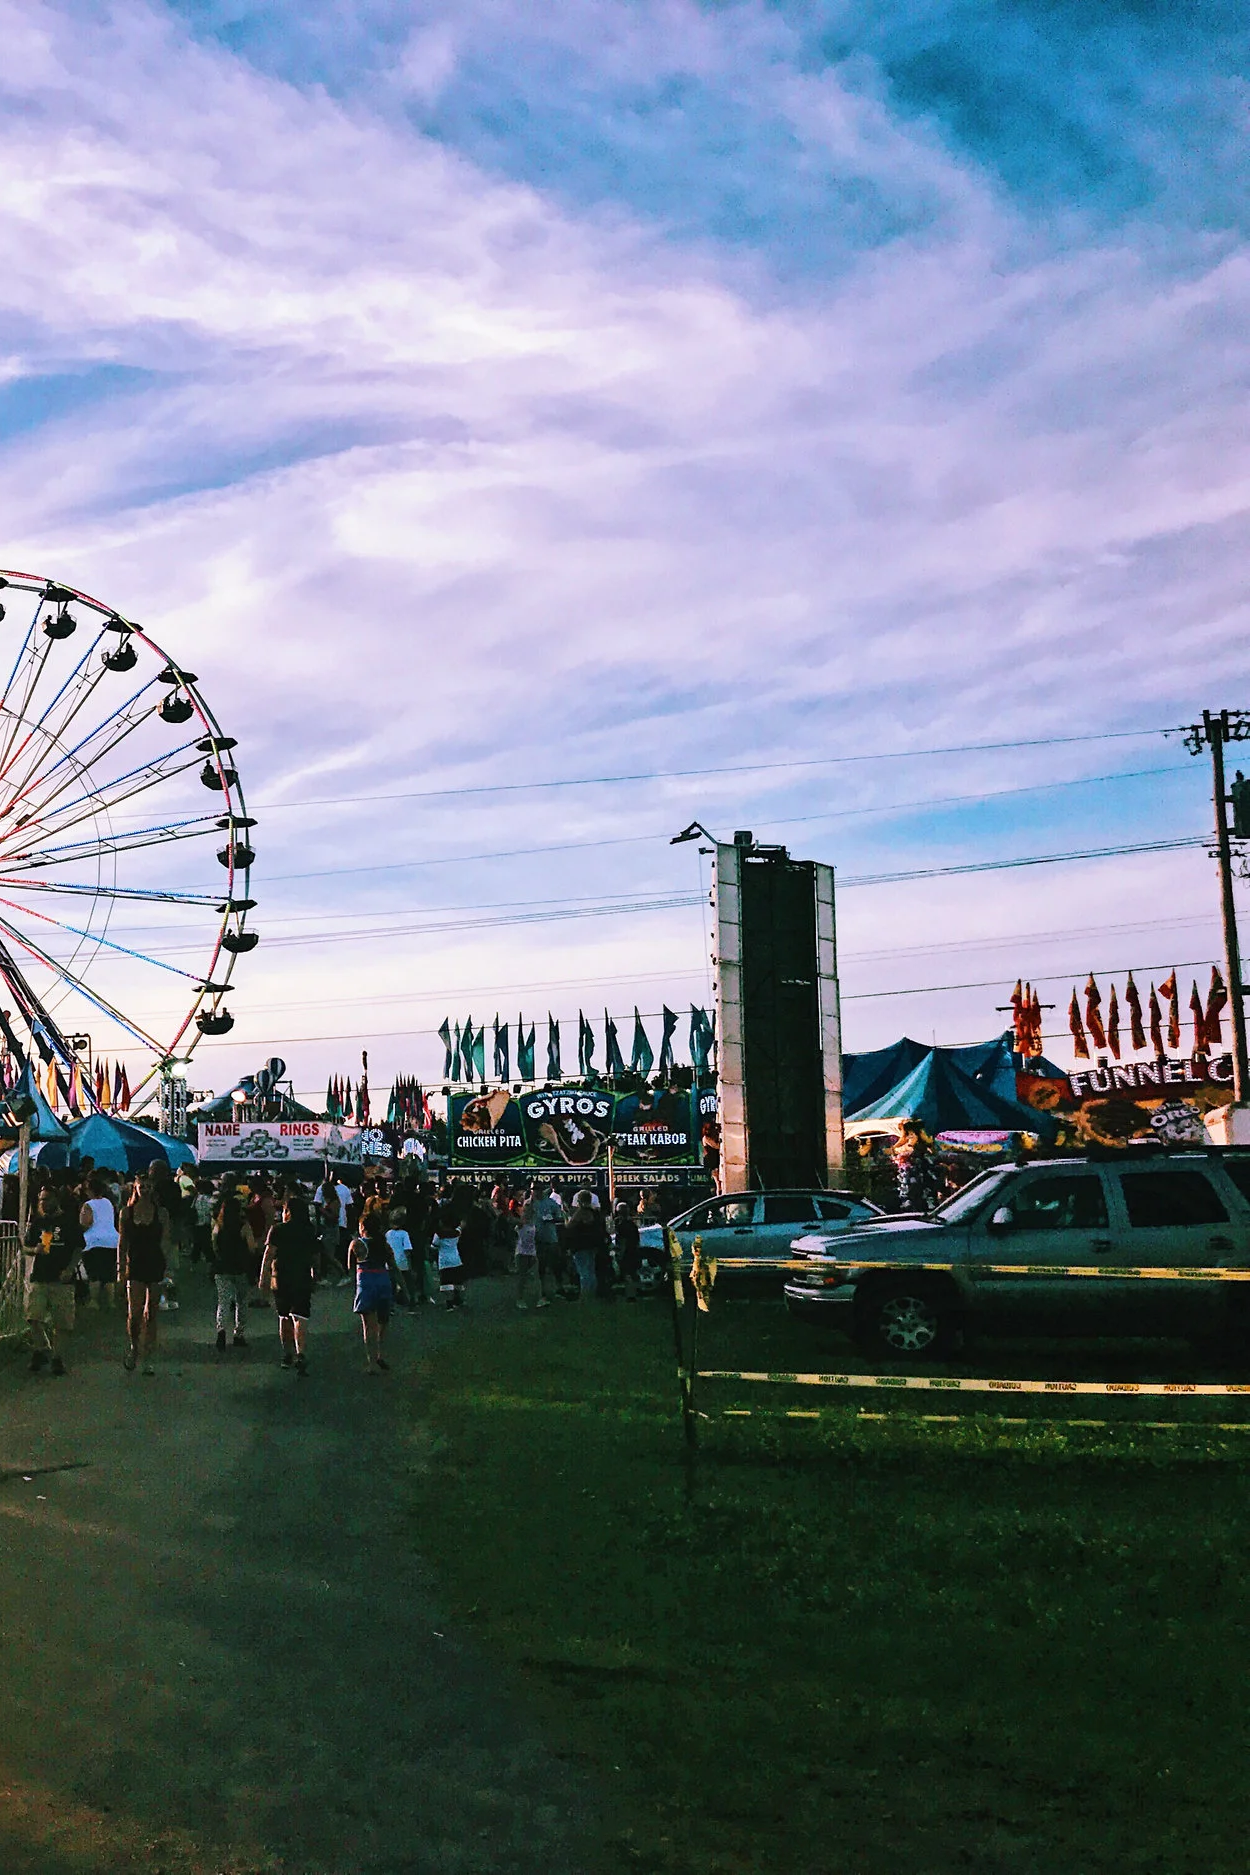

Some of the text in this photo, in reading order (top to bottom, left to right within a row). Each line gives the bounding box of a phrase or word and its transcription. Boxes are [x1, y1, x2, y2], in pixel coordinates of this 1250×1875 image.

[1068, 1059, 1203, 1097] FUNNEL
[527, 1097, 610, 1119] GYROS
[1150, 1106, 1200, 1127] OREO
[204, 1123, 319, 1137] NAME RINGS
[457, 1135, 522, 1147] CHICKEN PITA
[613, 1133, 687, 1145] TEAK KABOB
[643, 1174, 680, 1182] SALADS
